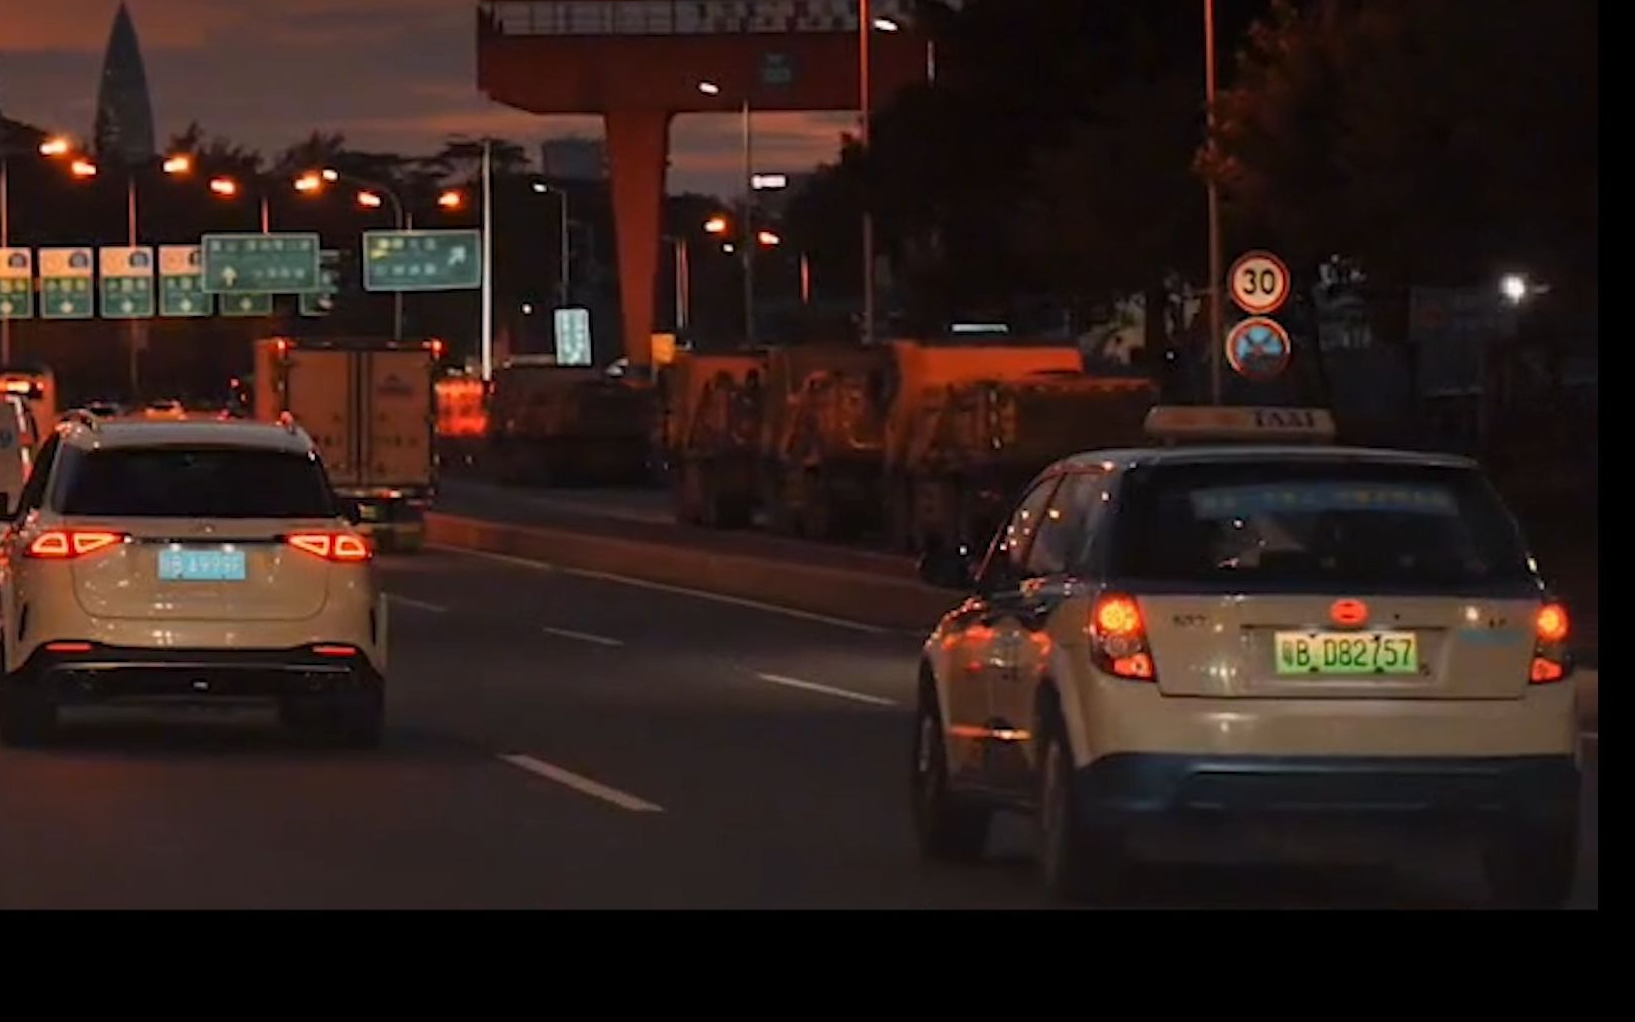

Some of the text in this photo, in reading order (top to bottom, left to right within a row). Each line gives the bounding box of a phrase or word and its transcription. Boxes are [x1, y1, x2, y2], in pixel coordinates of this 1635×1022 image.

[1242, 268, 1276, 295] 30
[1254, 411, 1315, 428] TAXI
[1323, 638, 1413, 667] D82757
